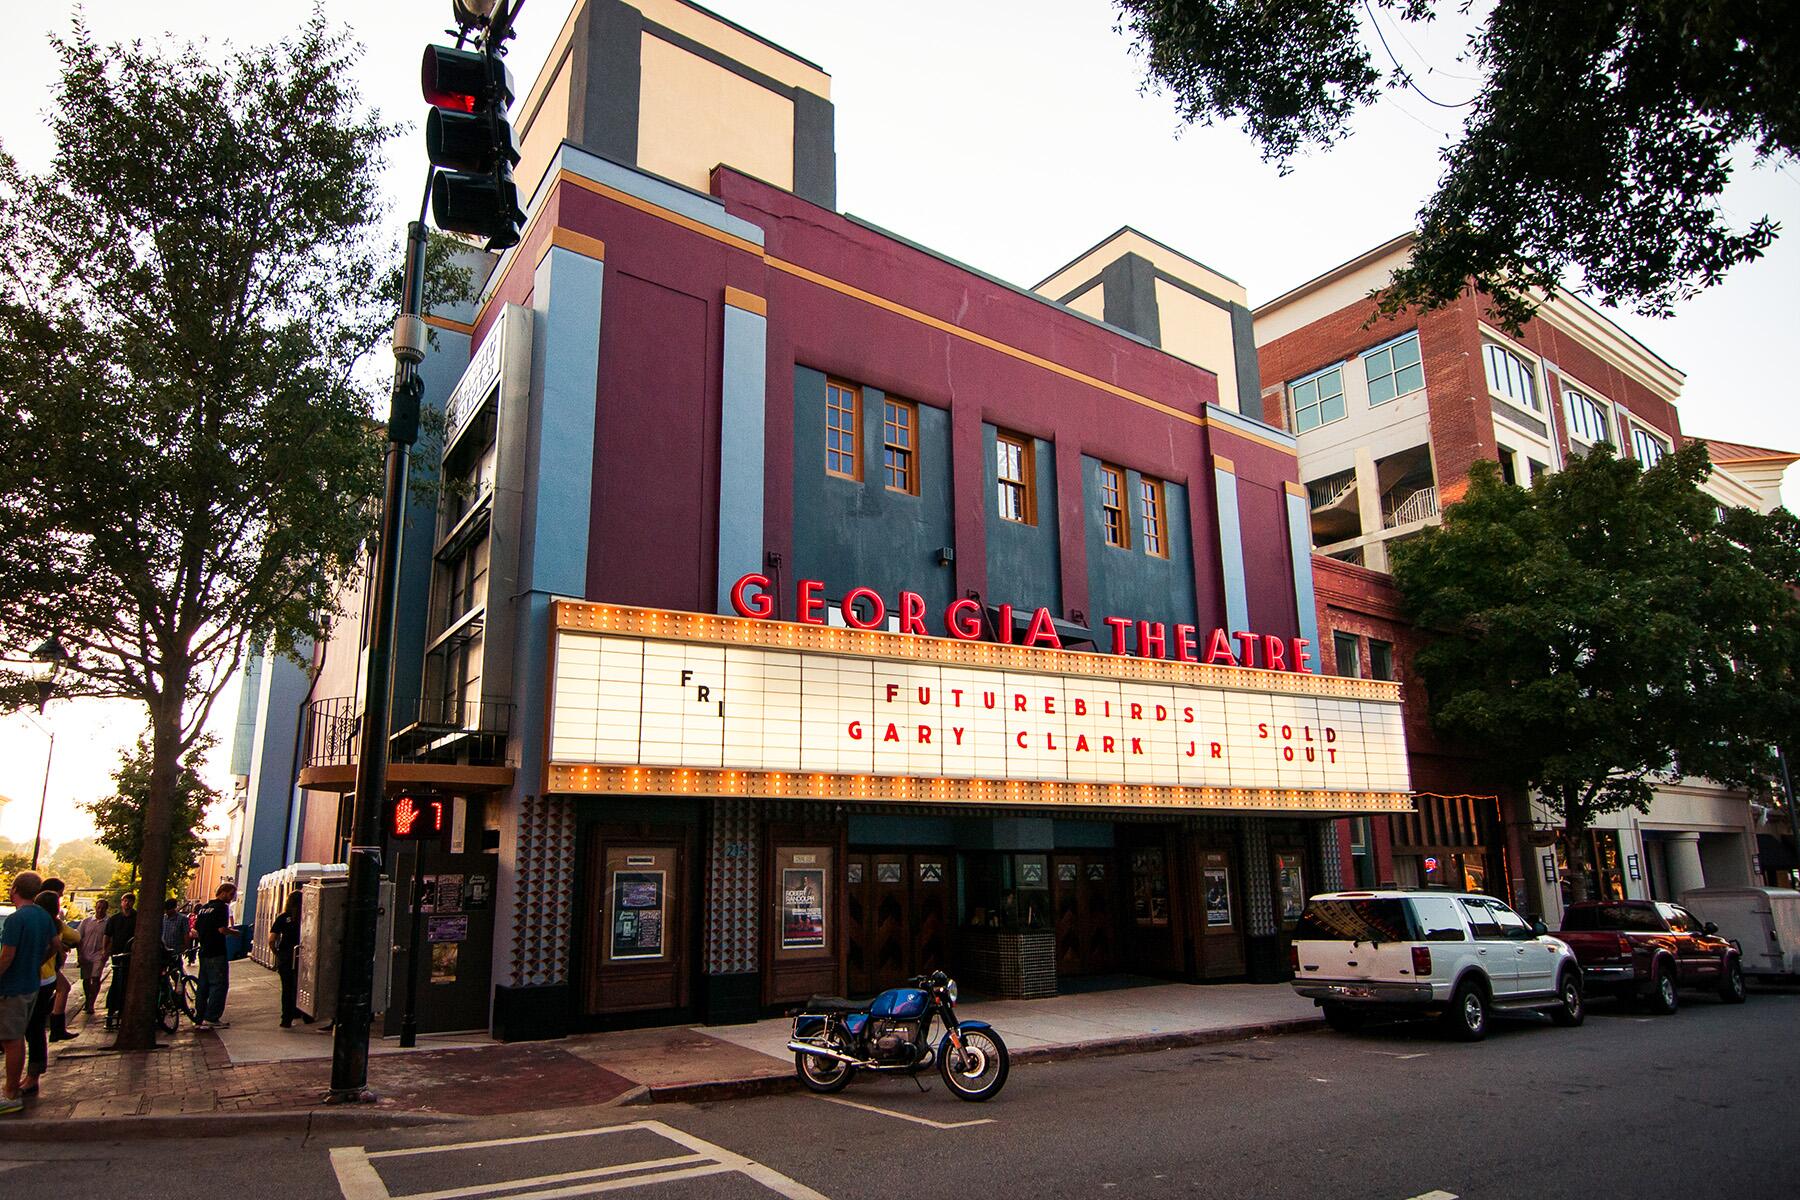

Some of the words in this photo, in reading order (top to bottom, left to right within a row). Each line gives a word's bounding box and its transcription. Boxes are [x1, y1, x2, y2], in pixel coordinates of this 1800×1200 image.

[730, 573, 1063, 650] GEORGIA
[1103, 615, 1313, 674] THEATRE
[681, 669, 724, 717] FRI
[886, 684, 1194, 723] FUTUREBIRDS
[848, 720, 965, 745] GARY
[1017, 731, 1144, 754] CLARK
[1186, 742, 1222, 758] JR
[1258, 723, 1337, 743] SOLD
[1283, 746, 1337, 764] OUT
